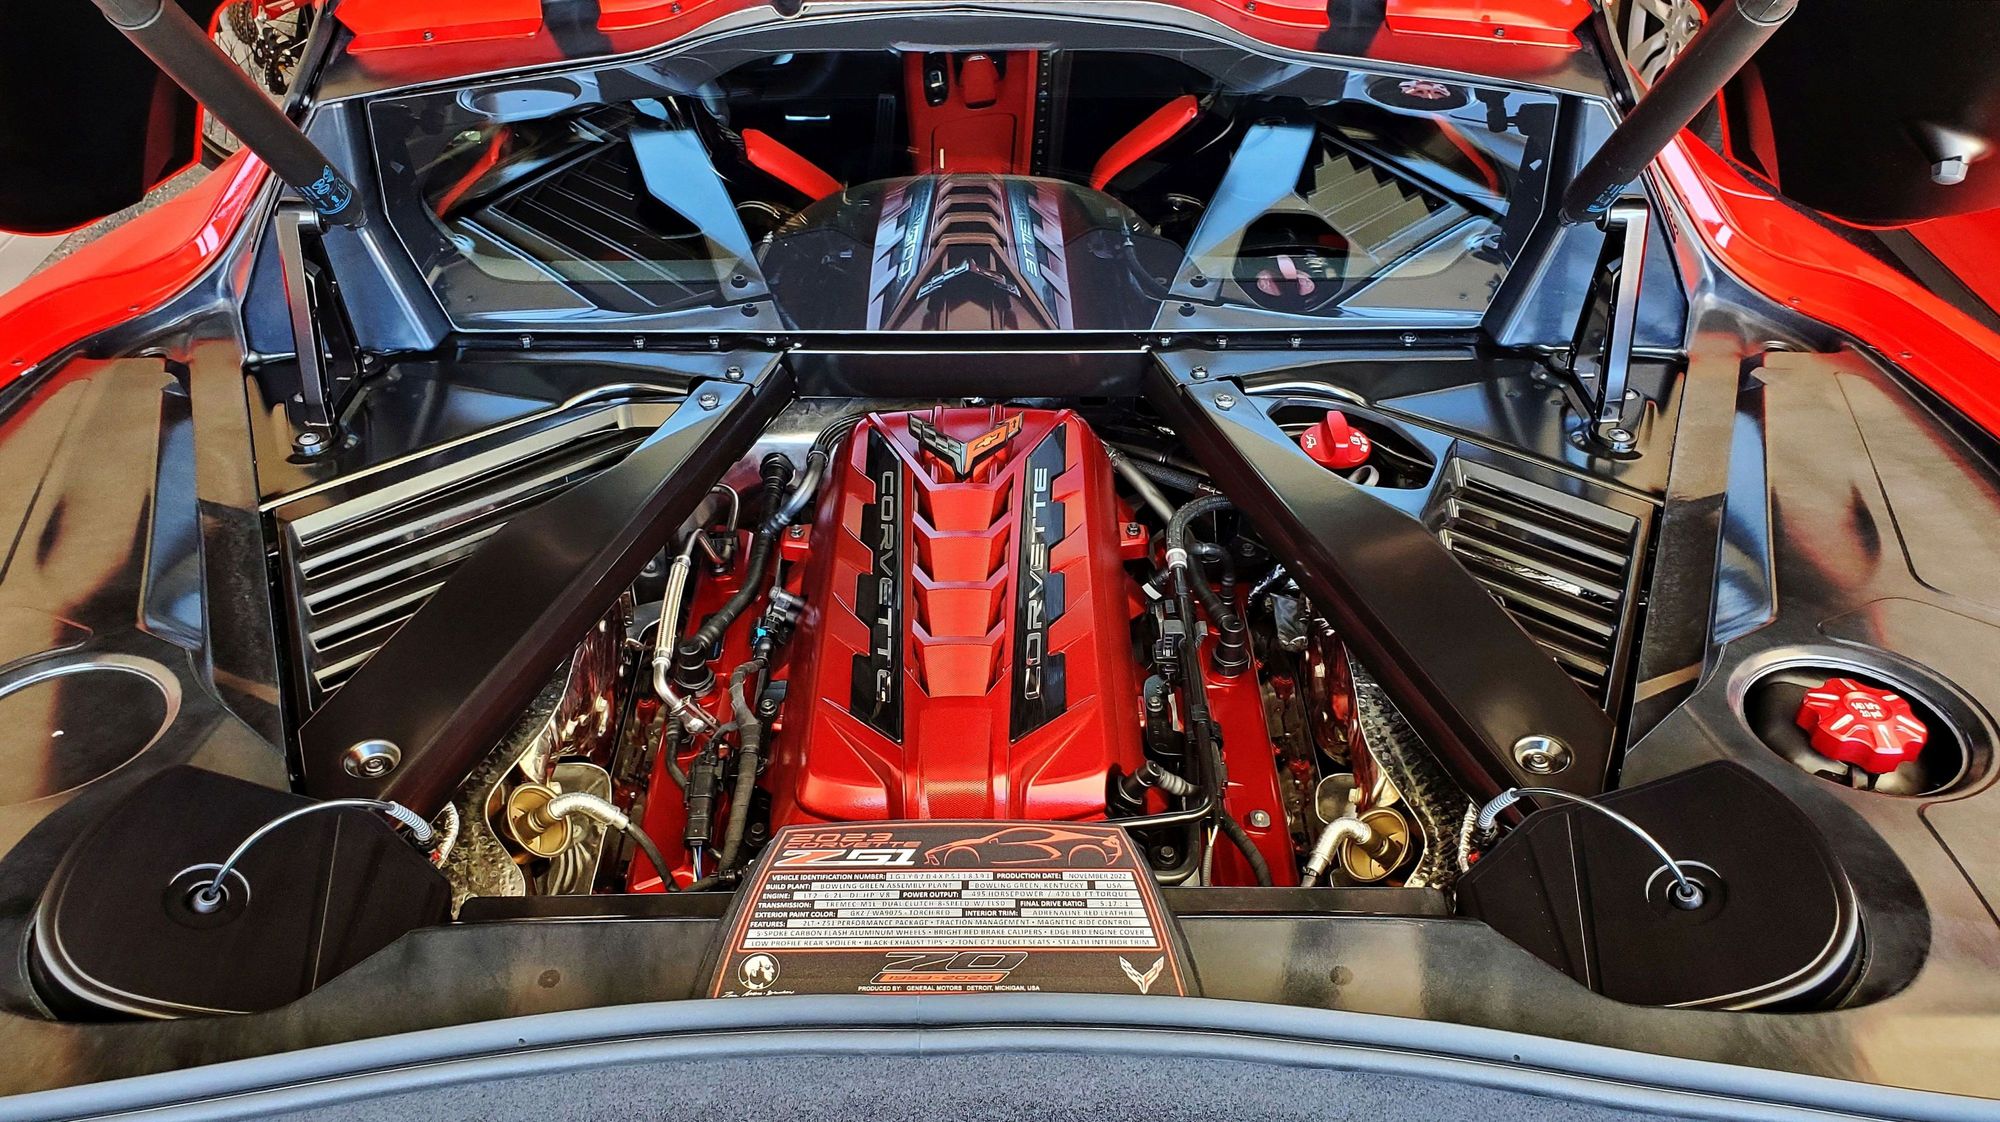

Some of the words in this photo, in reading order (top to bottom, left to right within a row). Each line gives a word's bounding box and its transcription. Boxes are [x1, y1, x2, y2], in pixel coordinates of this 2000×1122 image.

[876, 471, 894, 704] CORVETTE
[1025, 467, 1047, 700] CORVETTE
[789, 832, 894, 843] 2023
[774, 848, 917, 866] Z51
[882, 951, 1028, 971] 70
